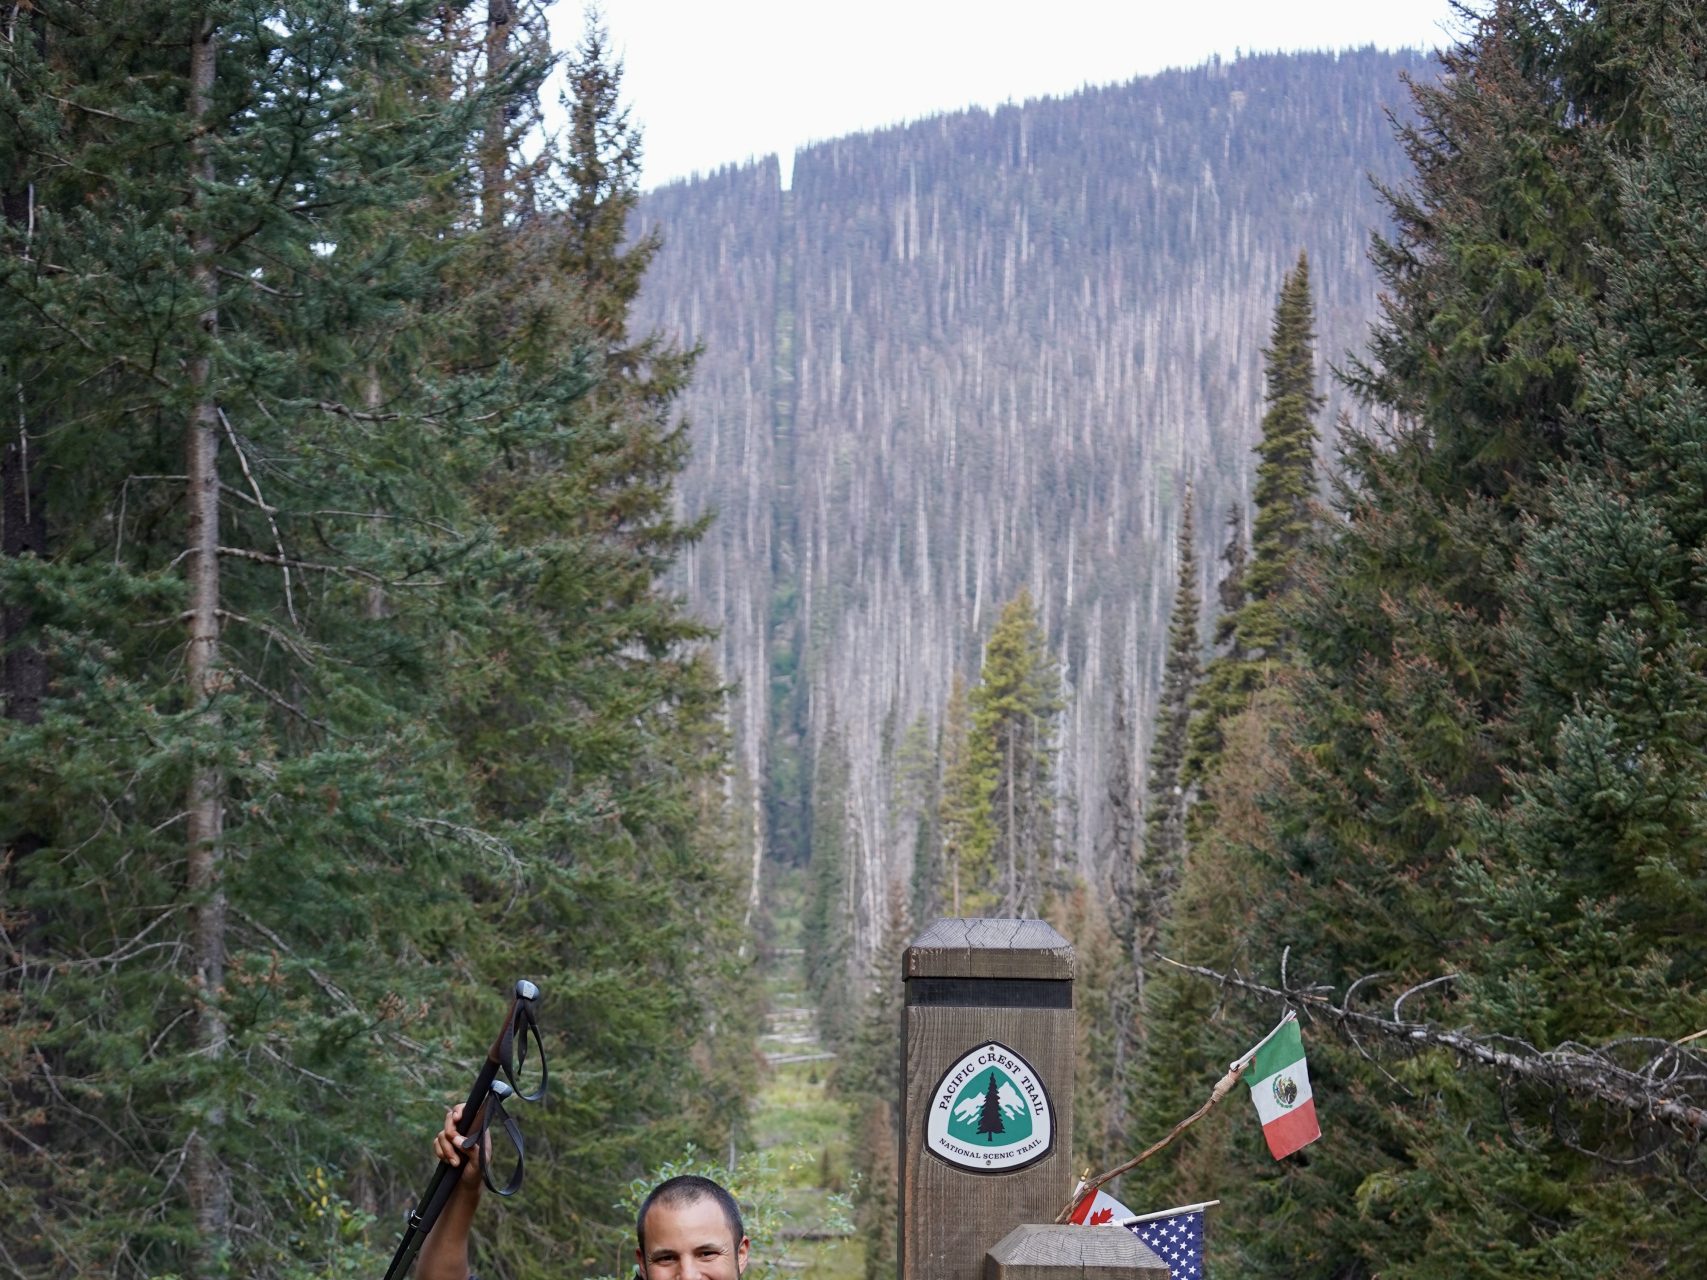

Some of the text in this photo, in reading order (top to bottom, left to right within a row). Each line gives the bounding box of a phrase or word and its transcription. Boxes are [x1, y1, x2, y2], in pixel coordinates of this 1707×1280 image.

[939, 1052, 1044, 1116] PACIFIC CREST TRAIL
[939, 1137, 1042, 1160] NATIONAL SCENIC TRAIL
